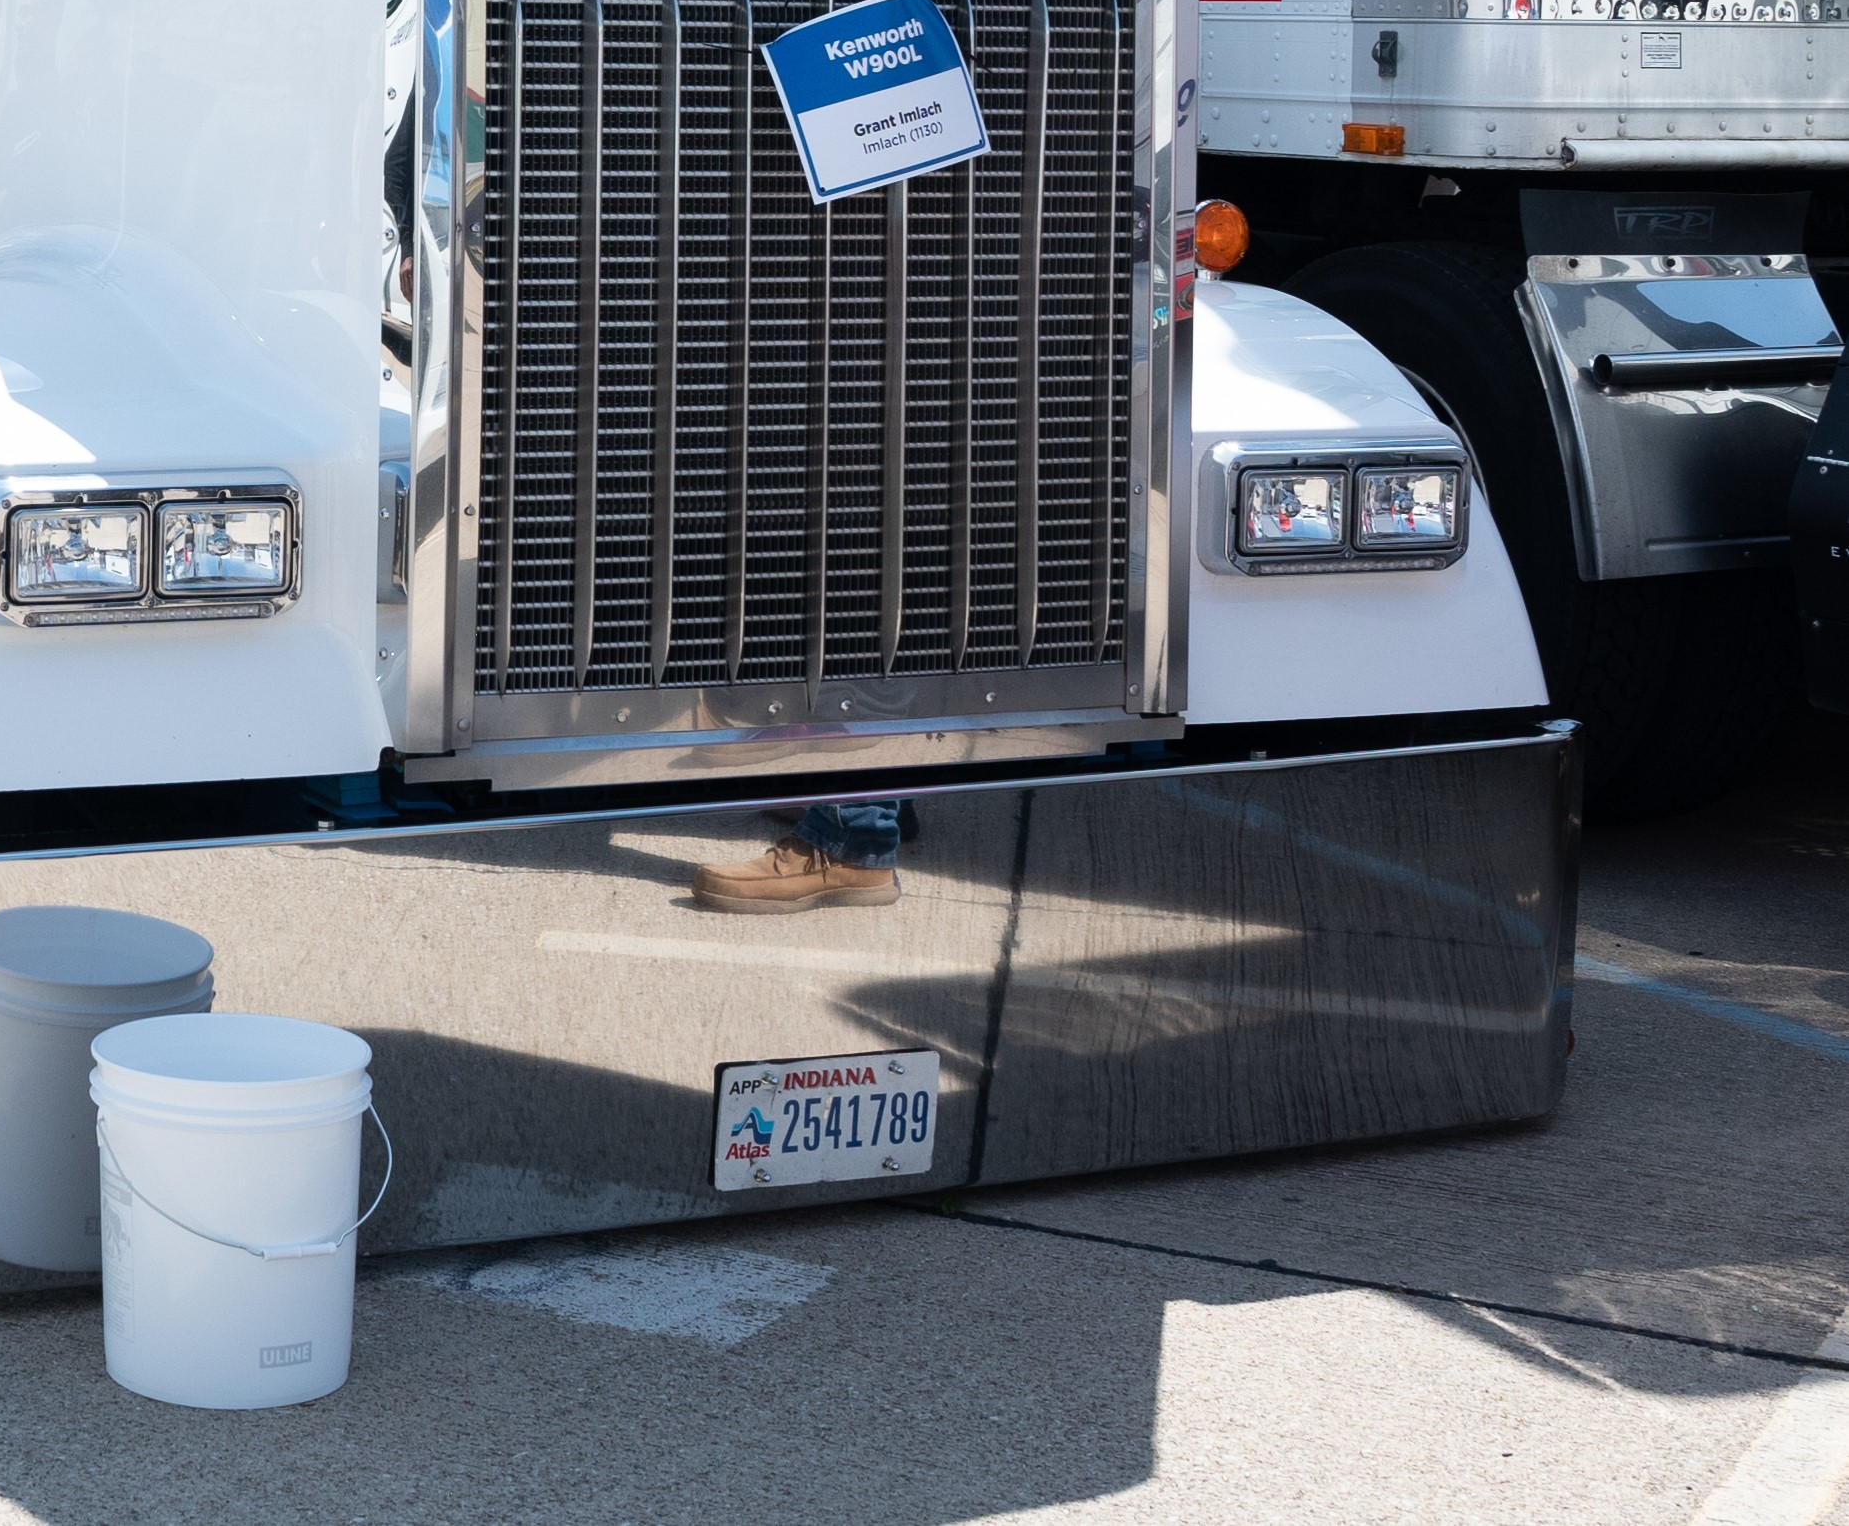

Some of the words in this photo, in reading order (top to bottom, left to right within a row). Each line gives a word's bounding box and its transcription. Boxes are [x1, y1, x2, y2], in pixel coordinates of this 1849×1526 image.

[824, 17, 924, 61] Kenworth
[843, 43, 923, 80] W900L
[853, 114, 897, 137] Grant
[899, 100, 943, 125] Imlach
[862, 132, 907, 155] Imlach
[909, 120, 944, 143] (1130)
[728, 1079, 762, 1096] APP
[783, 1066, 878, 1091] INDIANA
[781, 1090, 930, 1154] 2541789
[724, 1141, 771, 1161] Atlas
[262, 1344, 310, 1366] ULINE
